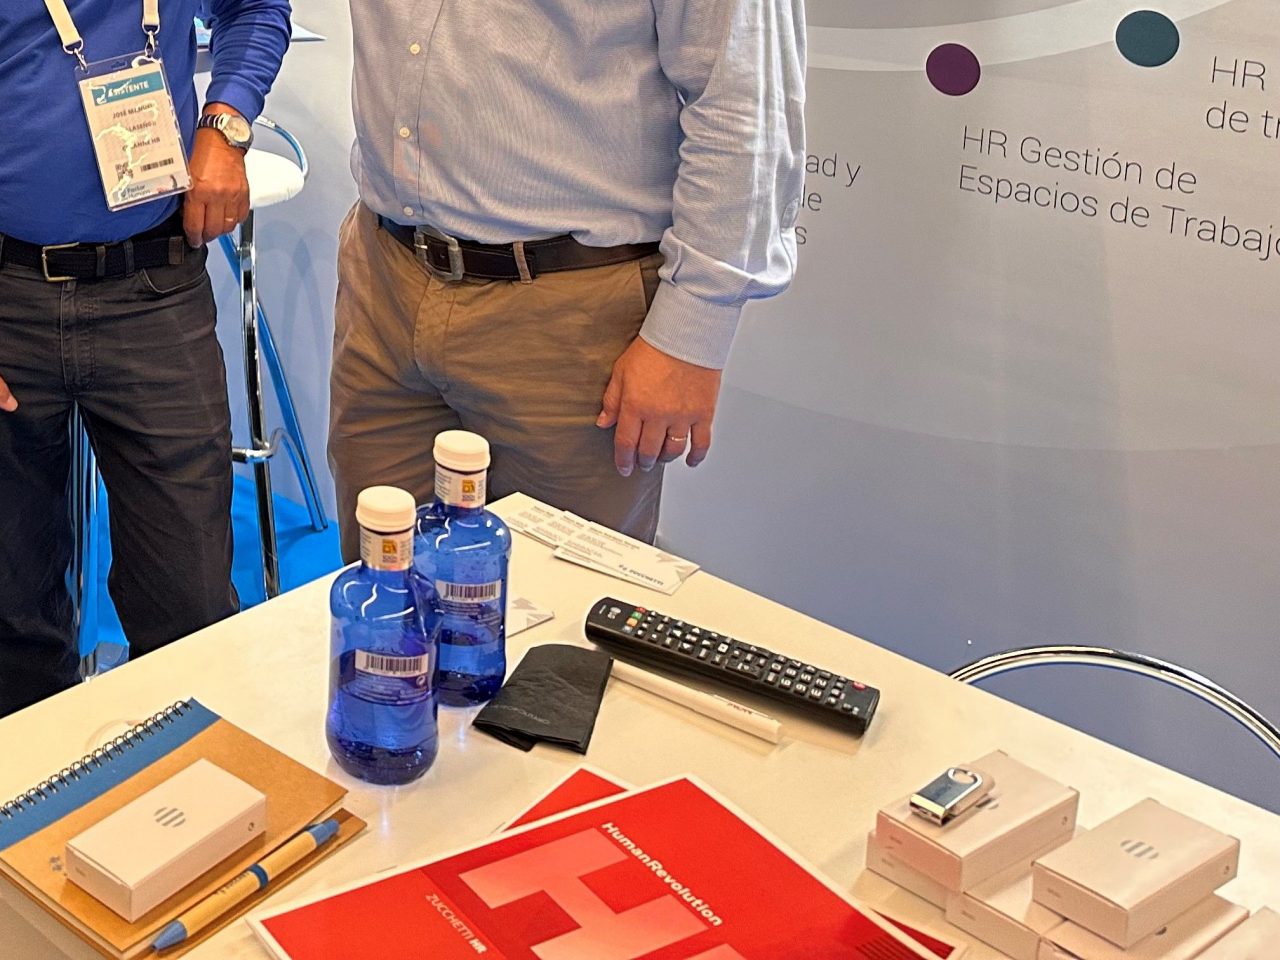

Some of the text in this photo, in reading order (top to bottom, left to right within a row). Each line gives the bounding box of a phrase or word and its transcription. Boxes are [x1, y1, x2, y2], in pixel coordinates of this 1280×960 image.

[1211, 56, 1266, 91] HR
[1206, 100, 1249, 133] de
[846, 162, 861, 187] y
[963, 125, 1197, 194] HR Gestión de
[959, 164, 1280, 261] Espacios de Trabaj
[601, 821, 723, 927] HumanRevolution
